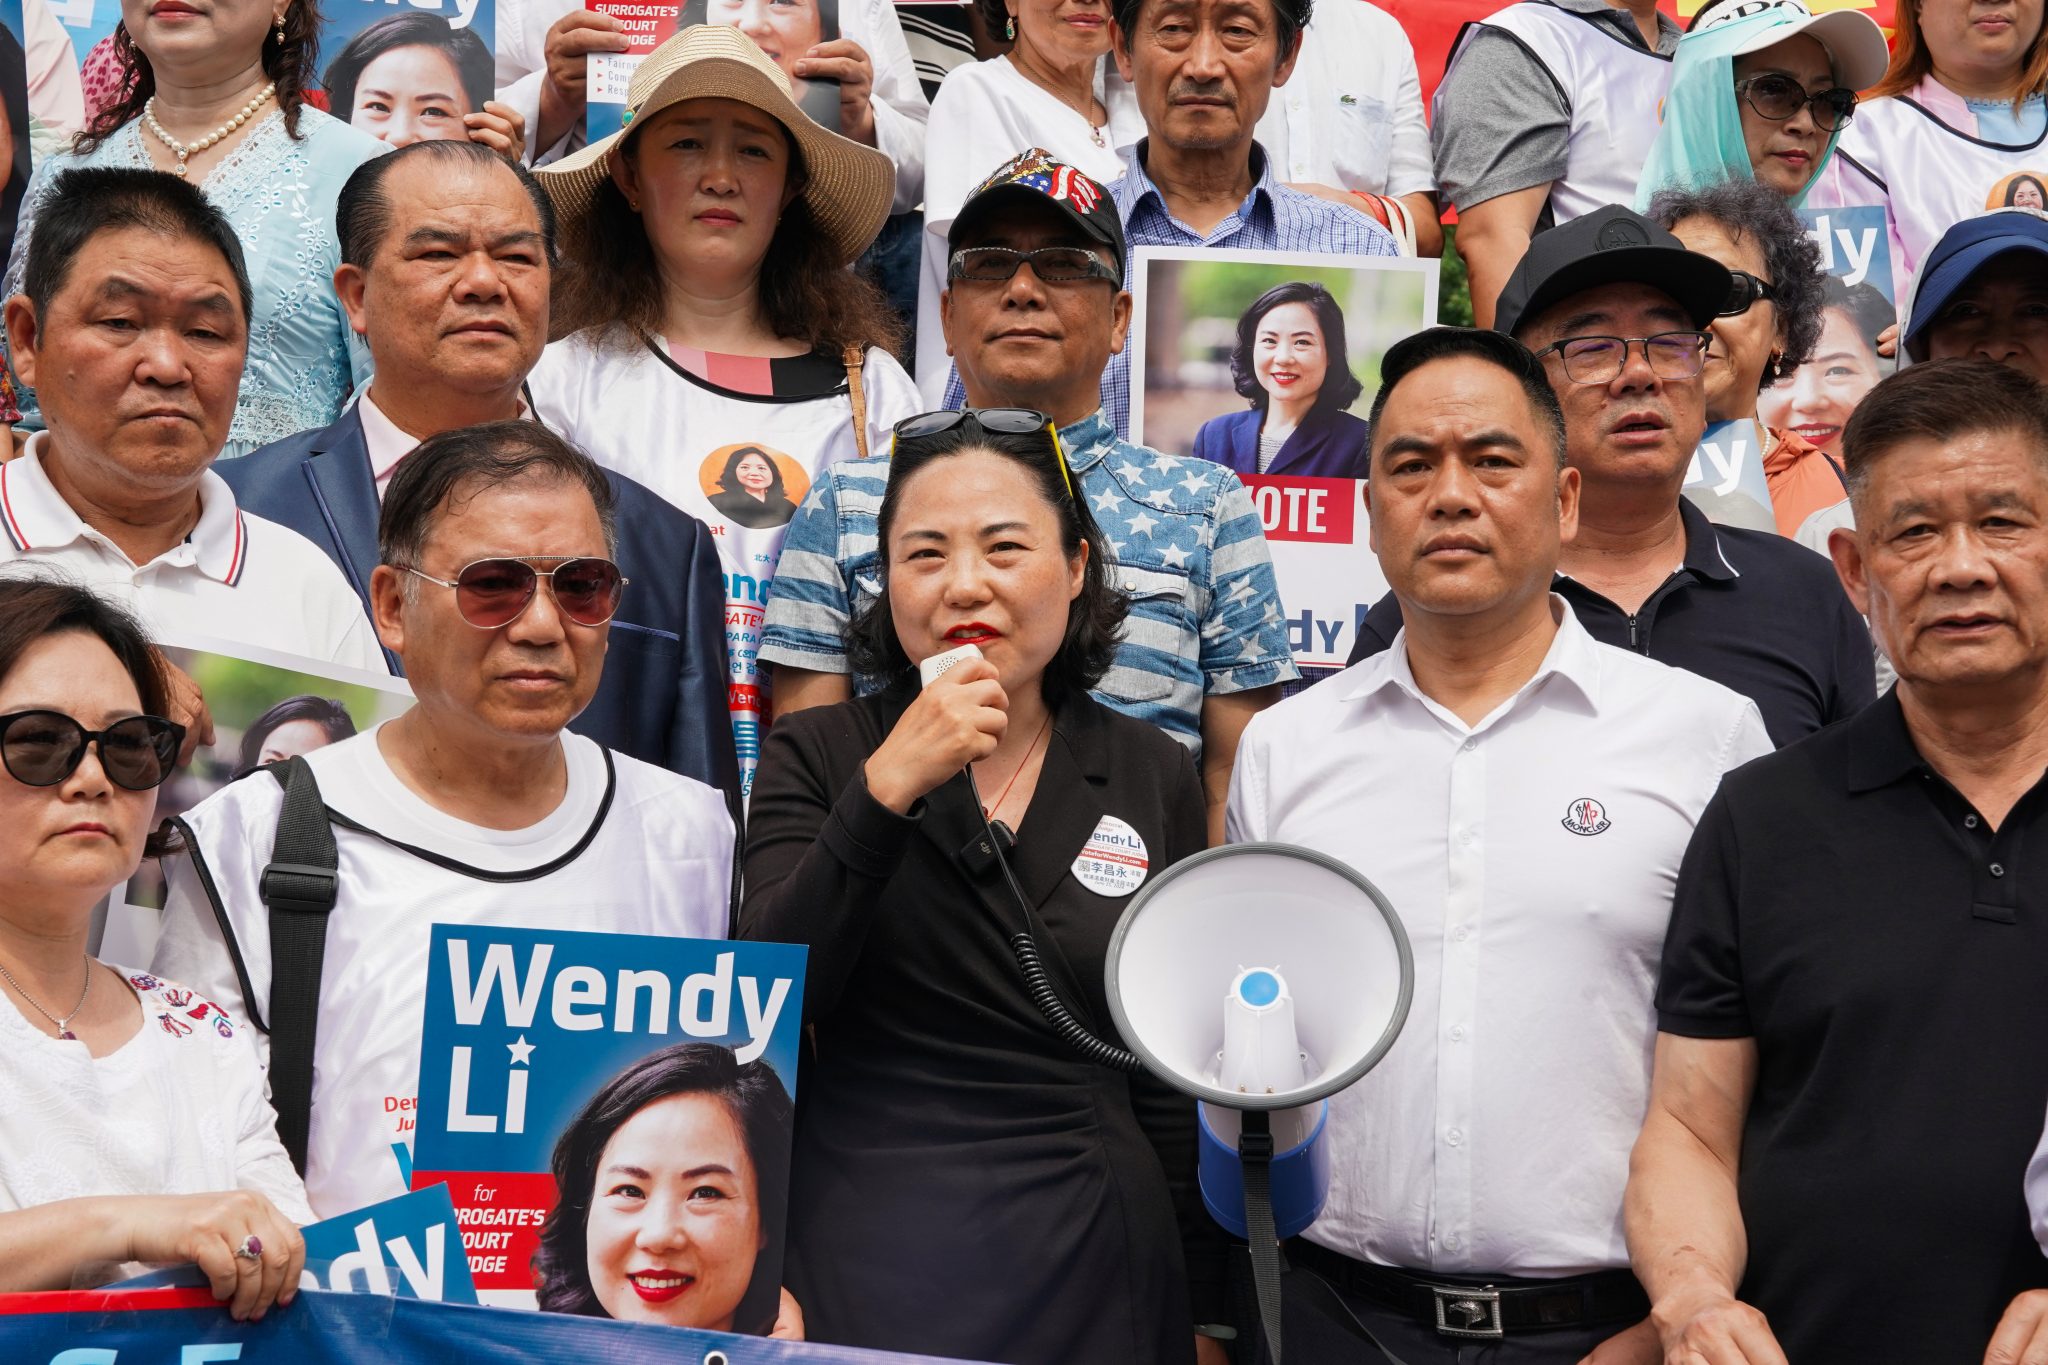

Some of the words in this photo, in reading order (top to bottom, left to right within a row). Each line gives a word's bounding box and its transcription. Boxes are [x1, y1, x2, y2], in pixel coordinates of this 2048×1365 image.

[595, 4, 679, 17] SURROGATE'S
[620, 20, 659, 31] OURT
[608, 58, 638, 70] Fairne
[1245, 486, 1328, 533] OTE
[1565, 819, 1608, 833] MONCLER
[1128, 835, 1141, 849] Li
[1091, 861, 1127, 878] 李昌永
[446, 939, 793, 1066] Wendy
[446, 1033, 537, 1134] Li
[473, 1184, 497, 1201] for
[460, 1232, 513, 1249] OURT
[301, 1218, 446, 1302] dy
